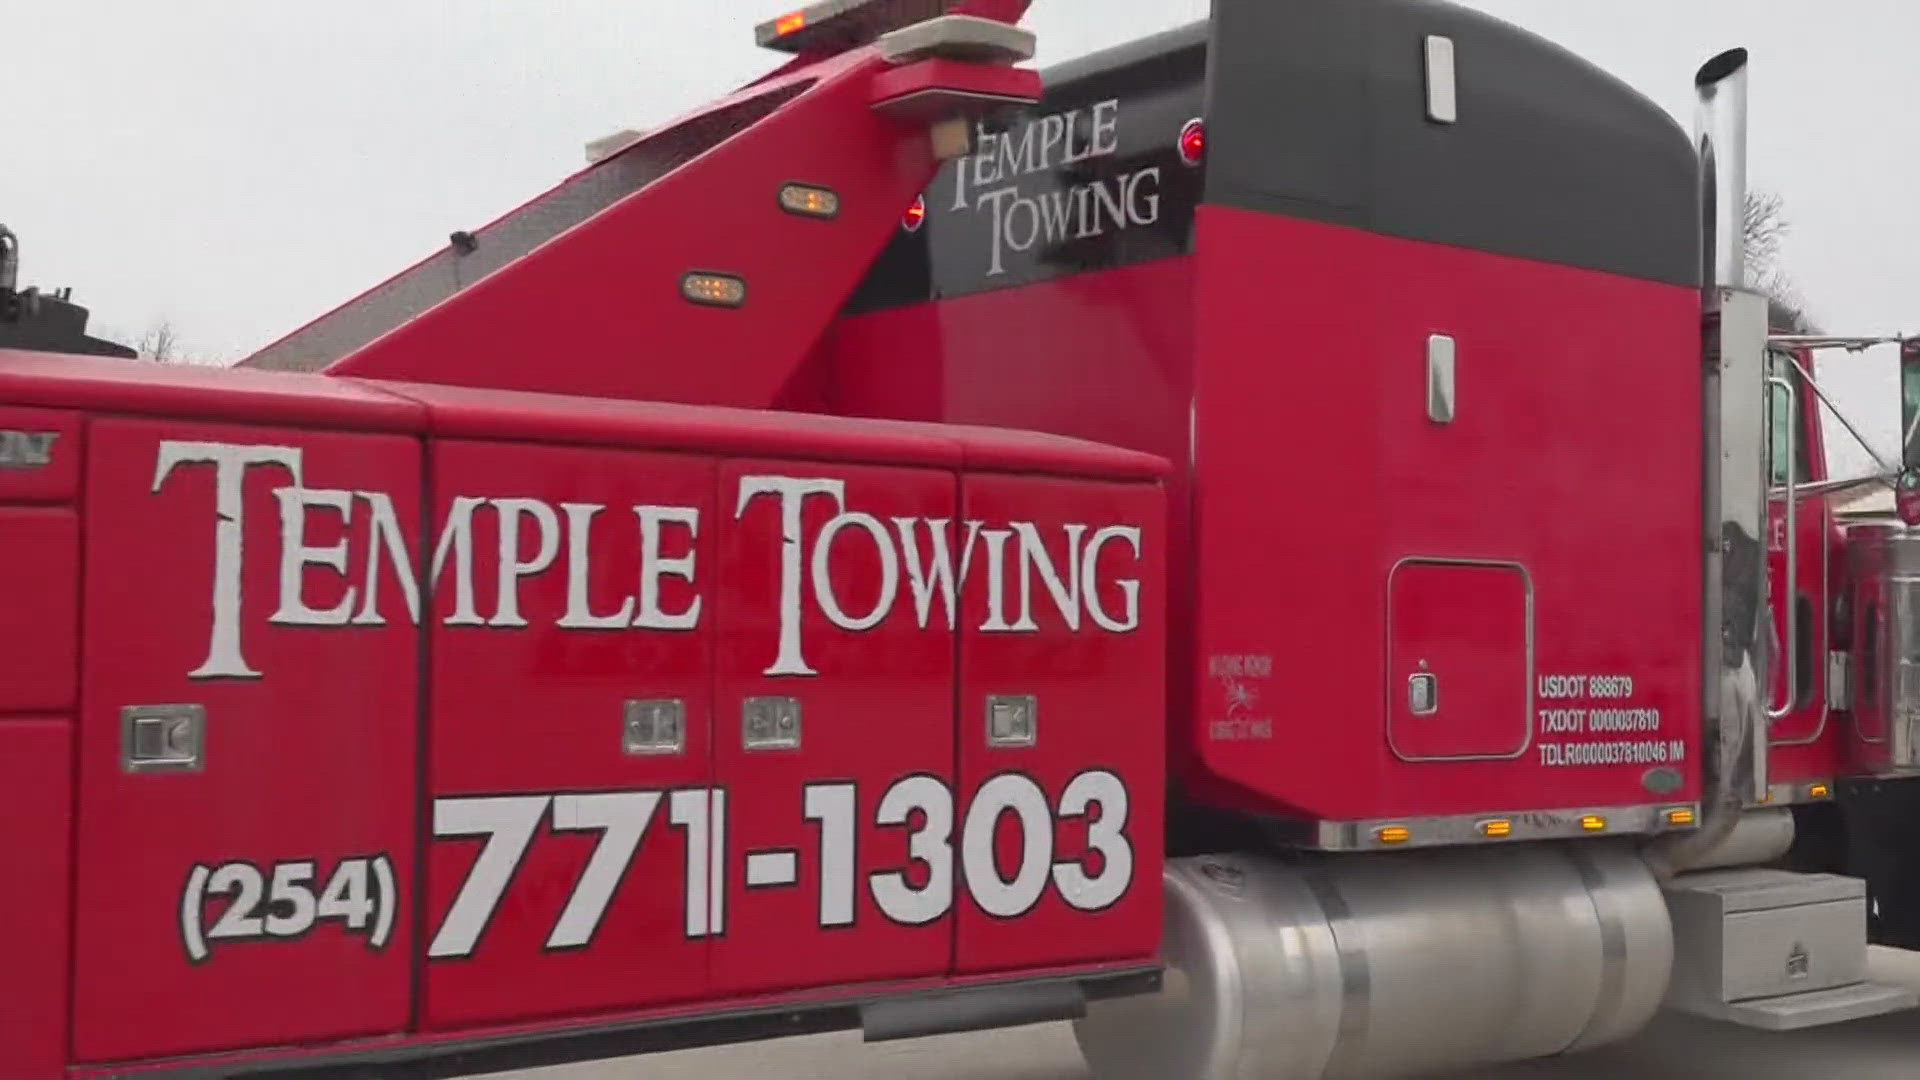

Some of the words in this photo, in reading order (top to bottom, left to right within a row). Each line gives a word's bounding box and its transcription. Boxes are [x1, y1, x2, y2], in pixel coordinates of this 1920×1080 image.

[976, 167, 1160, 277] TOWING
[151, 440, 702, 678] TEMPLE
[734, 475, 1142, 677] TOWING
[1538, 675, 1586, 698] USDOT
[1589, 676, 1633, 698] 888679
[1539, 709, 1586, 733] TXDOT
[180, 852, 397, 966] (254)
[427, 769, 1135, 960] 771-1303
